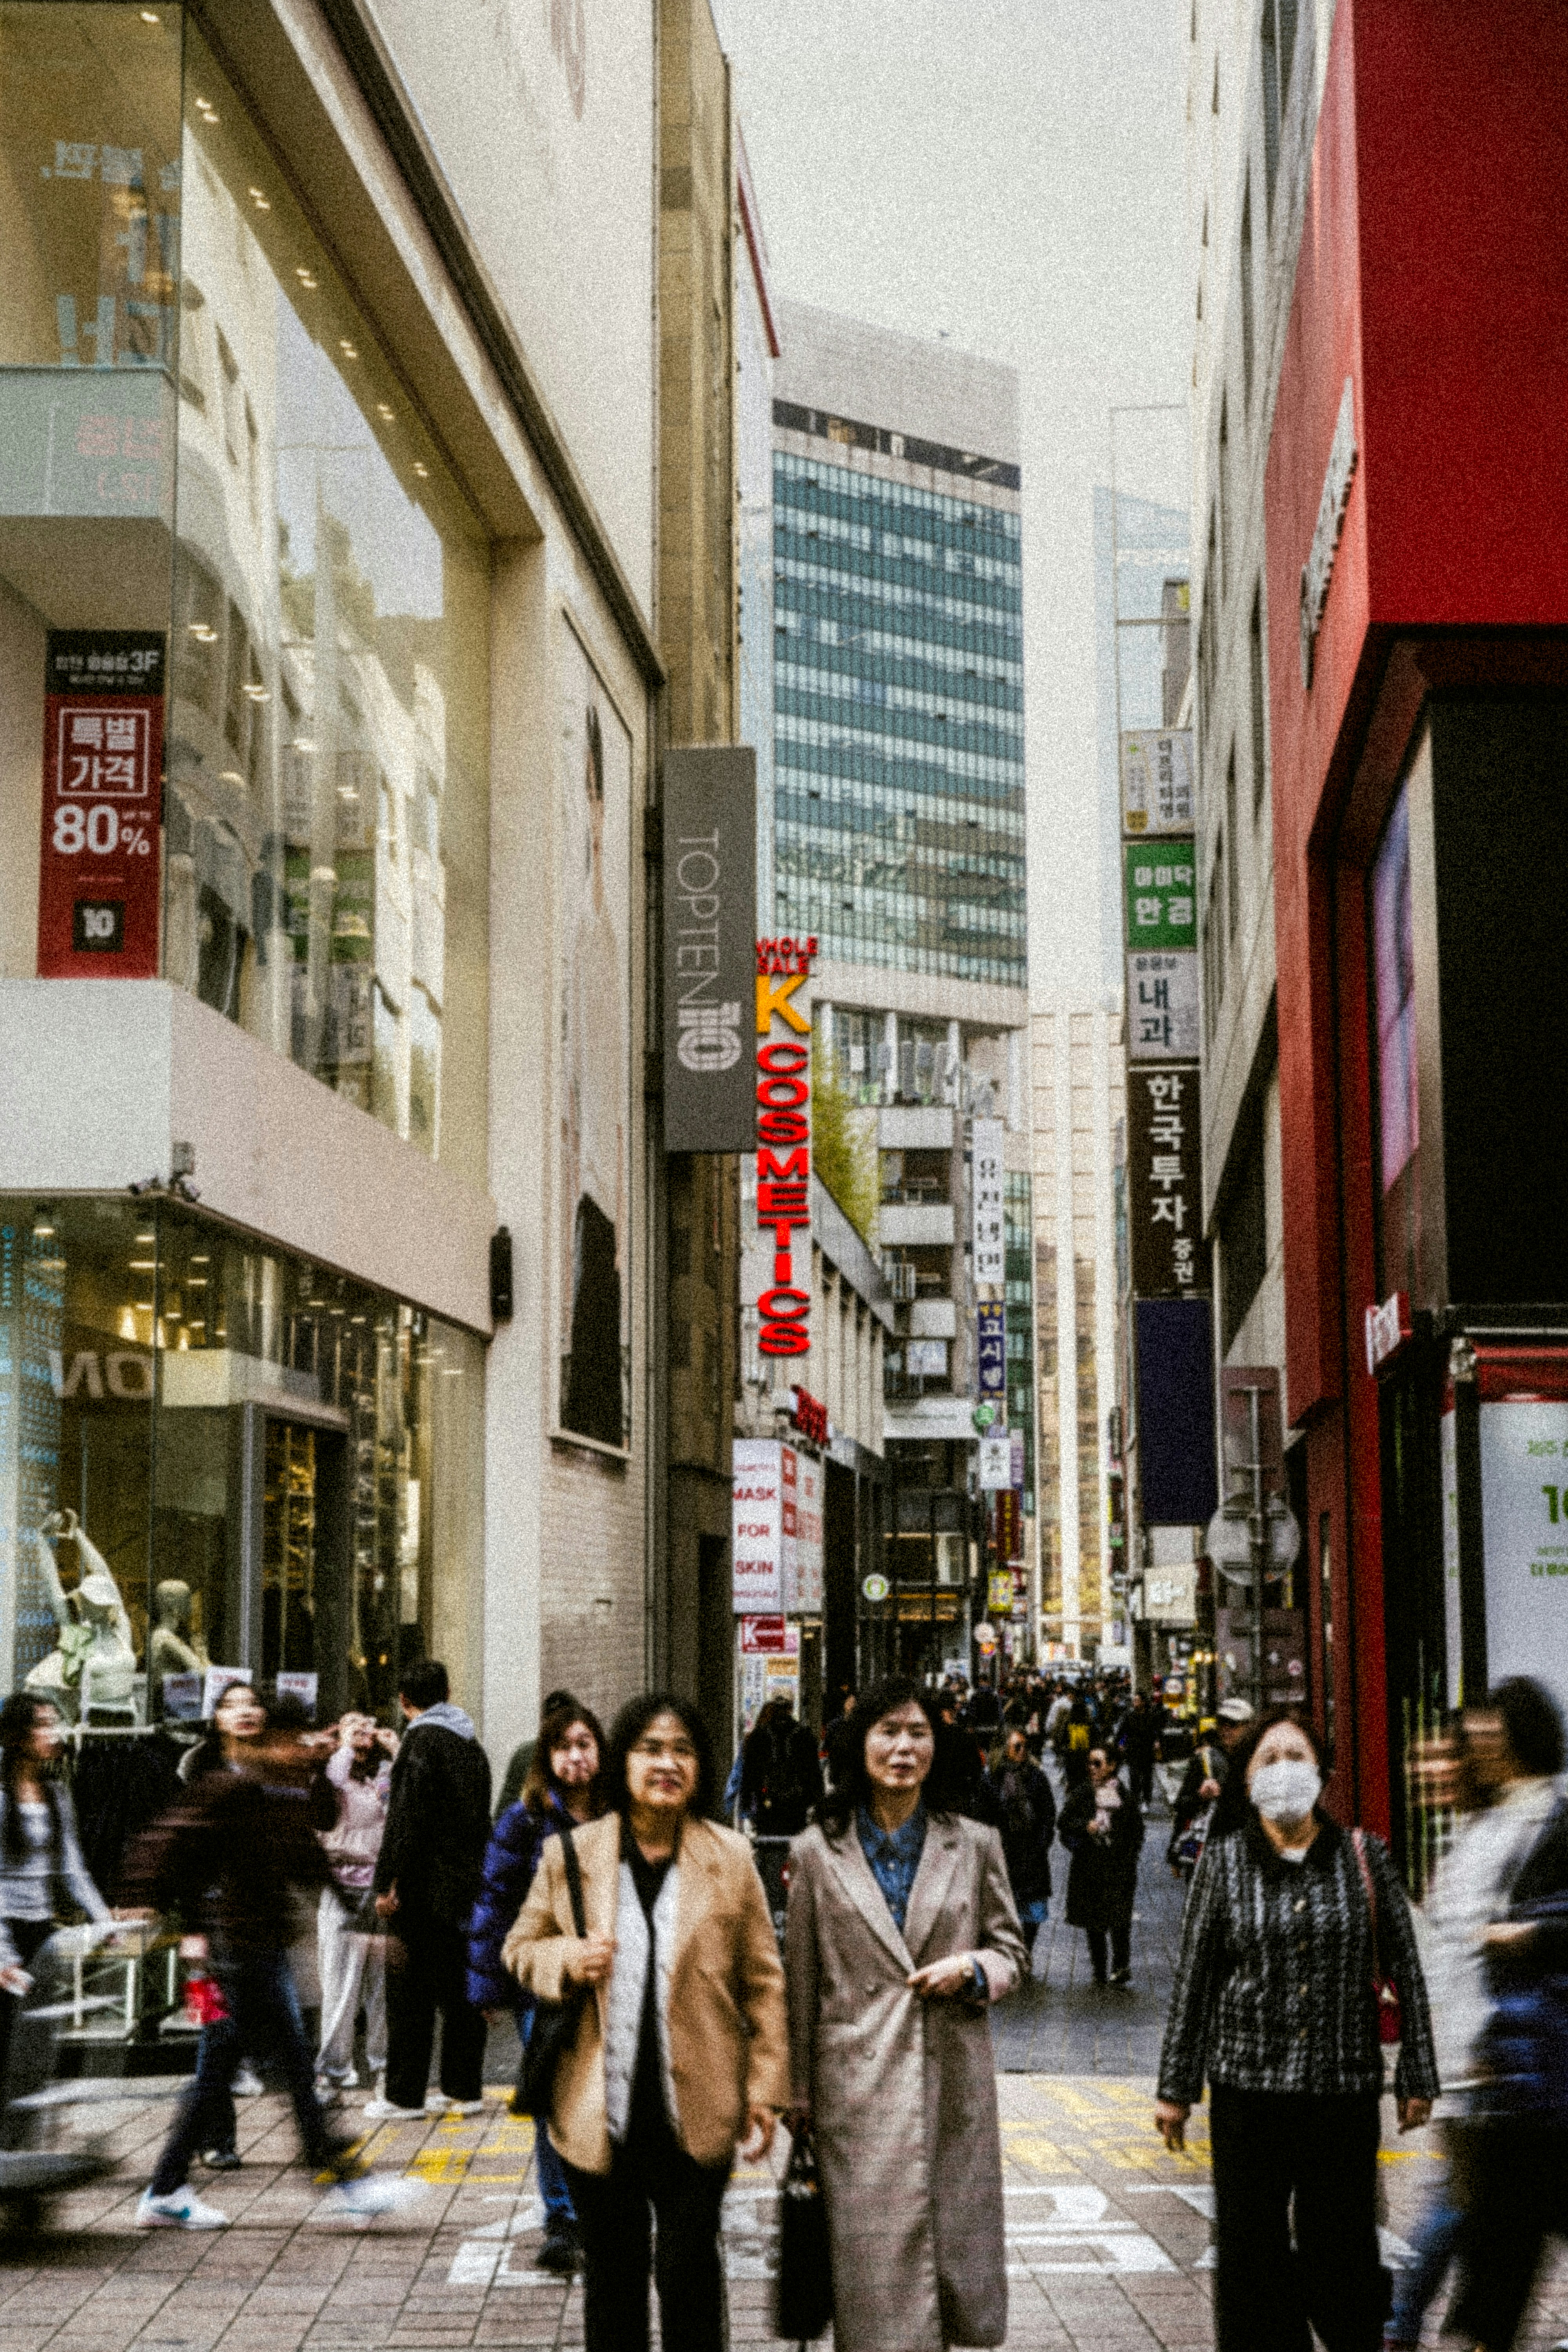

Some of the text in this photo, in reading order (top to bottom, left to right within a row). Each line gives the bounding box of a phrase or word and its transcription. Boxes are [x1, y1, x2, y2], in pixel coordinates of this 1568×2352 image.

[131, 650, 160, 672] 3F
[71, 715, 136, 752] 특별
[69, 755, 135, 790] 가격
[52, 804, 151, 856] 80%
[757, 956, 810, 975] SALE
[756, 975, 813, 1033] K
[757, 1043, 811, 1355] COSMETICS
[738, 1524, 770, 1537] FOR
[735, 1561, 774, 1574] SKIN
